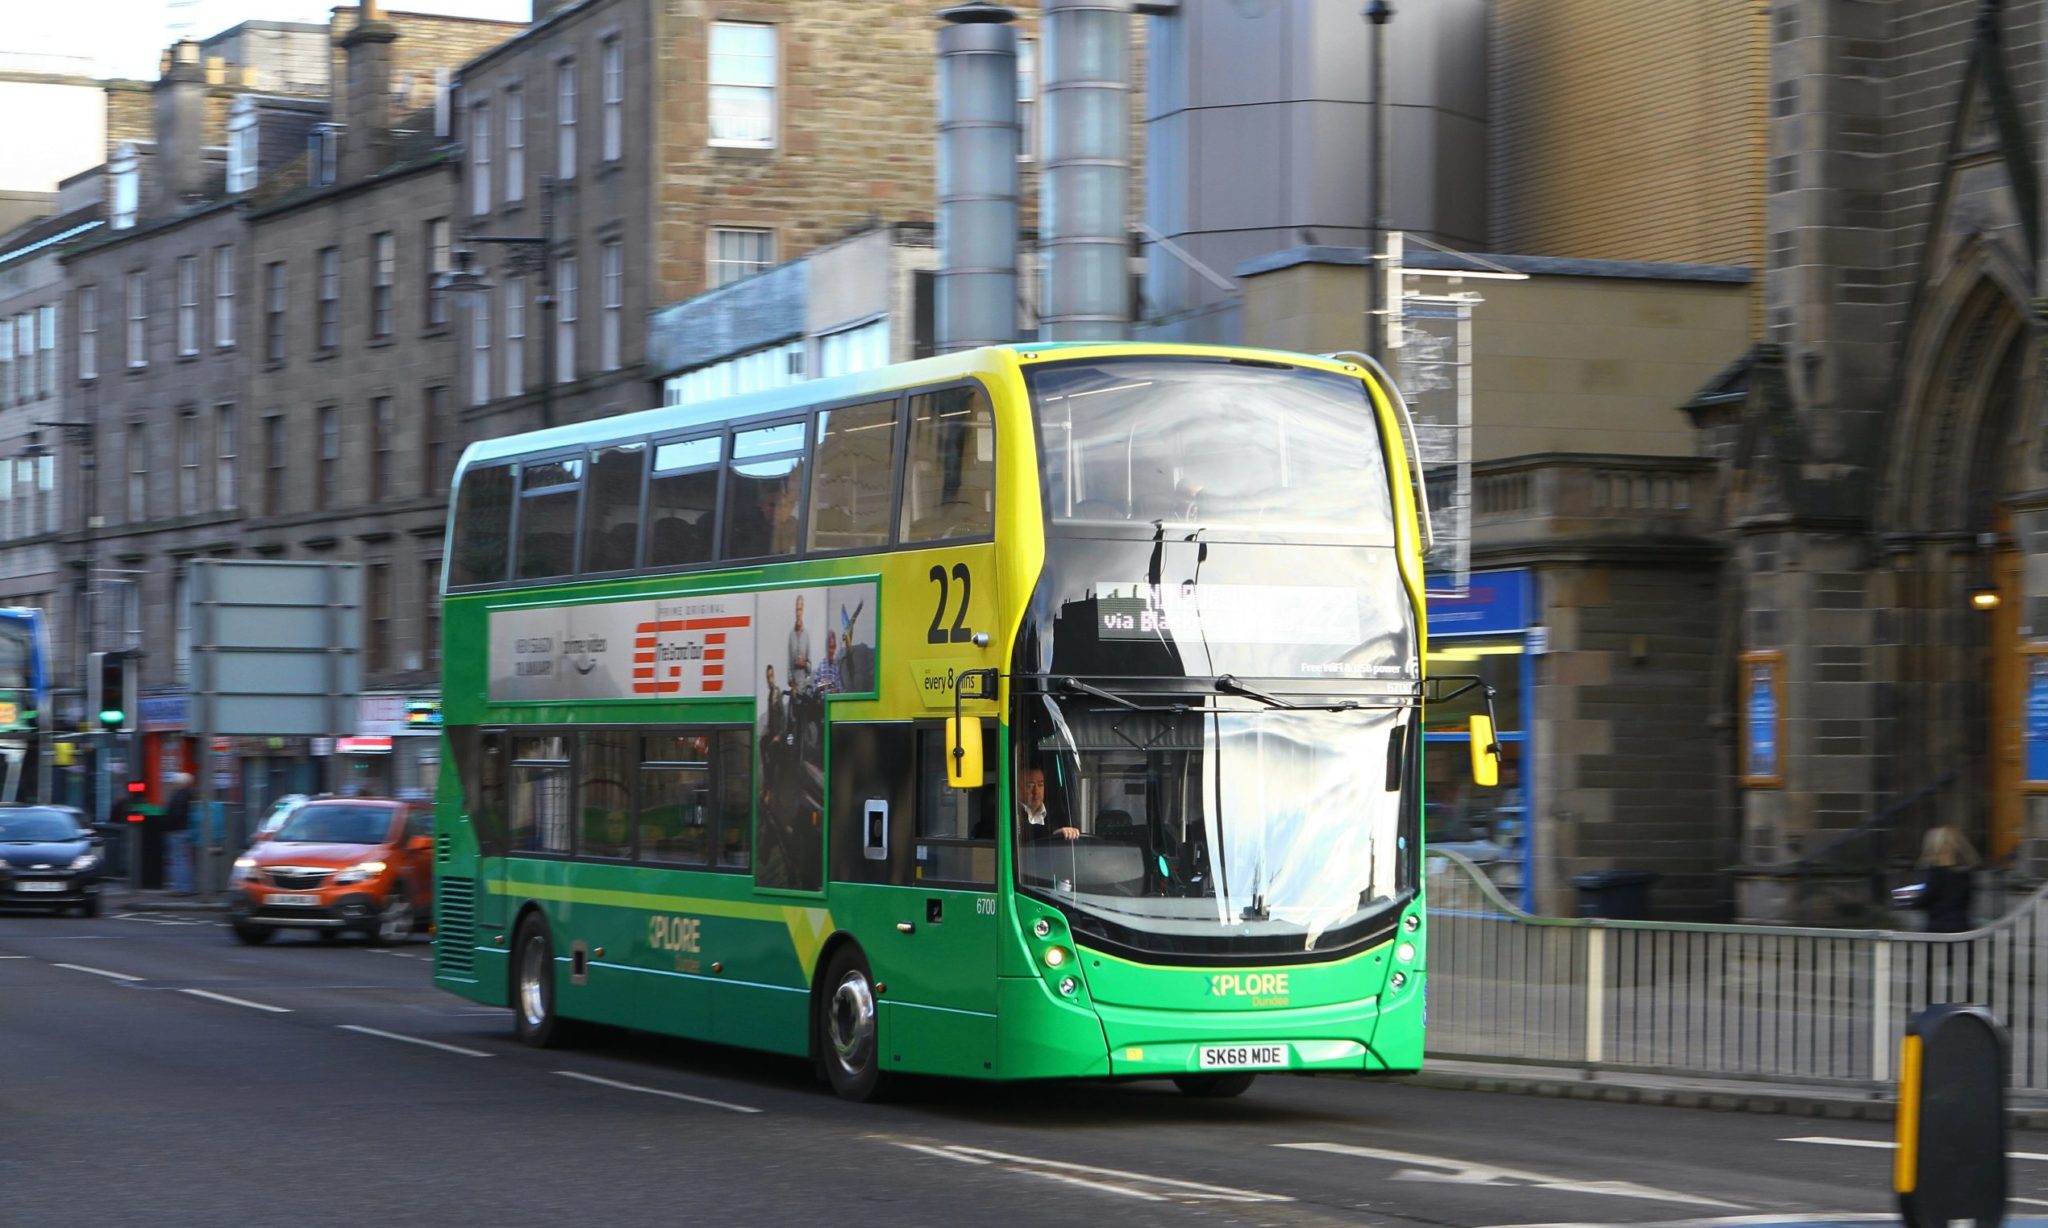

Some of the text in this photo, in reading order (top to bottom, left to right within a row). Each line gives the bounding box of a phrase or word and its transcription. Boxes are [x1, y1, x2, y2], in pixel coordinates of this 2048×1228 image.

[928, 562, 972, 644] 22
[1104, 612, 1134, 629] via
[1373, 665, 1401, 676] power
[924, 676, 946, 694] every
[947, 668, 954, 690] 8
[976, 898, 996, 915] 6700
[1204, 974, 1289, 996] XPLORE
[1252, 996, 1290, 1007] Dundee
[1206, 1047, 1281, 1065] SK68 MDE
